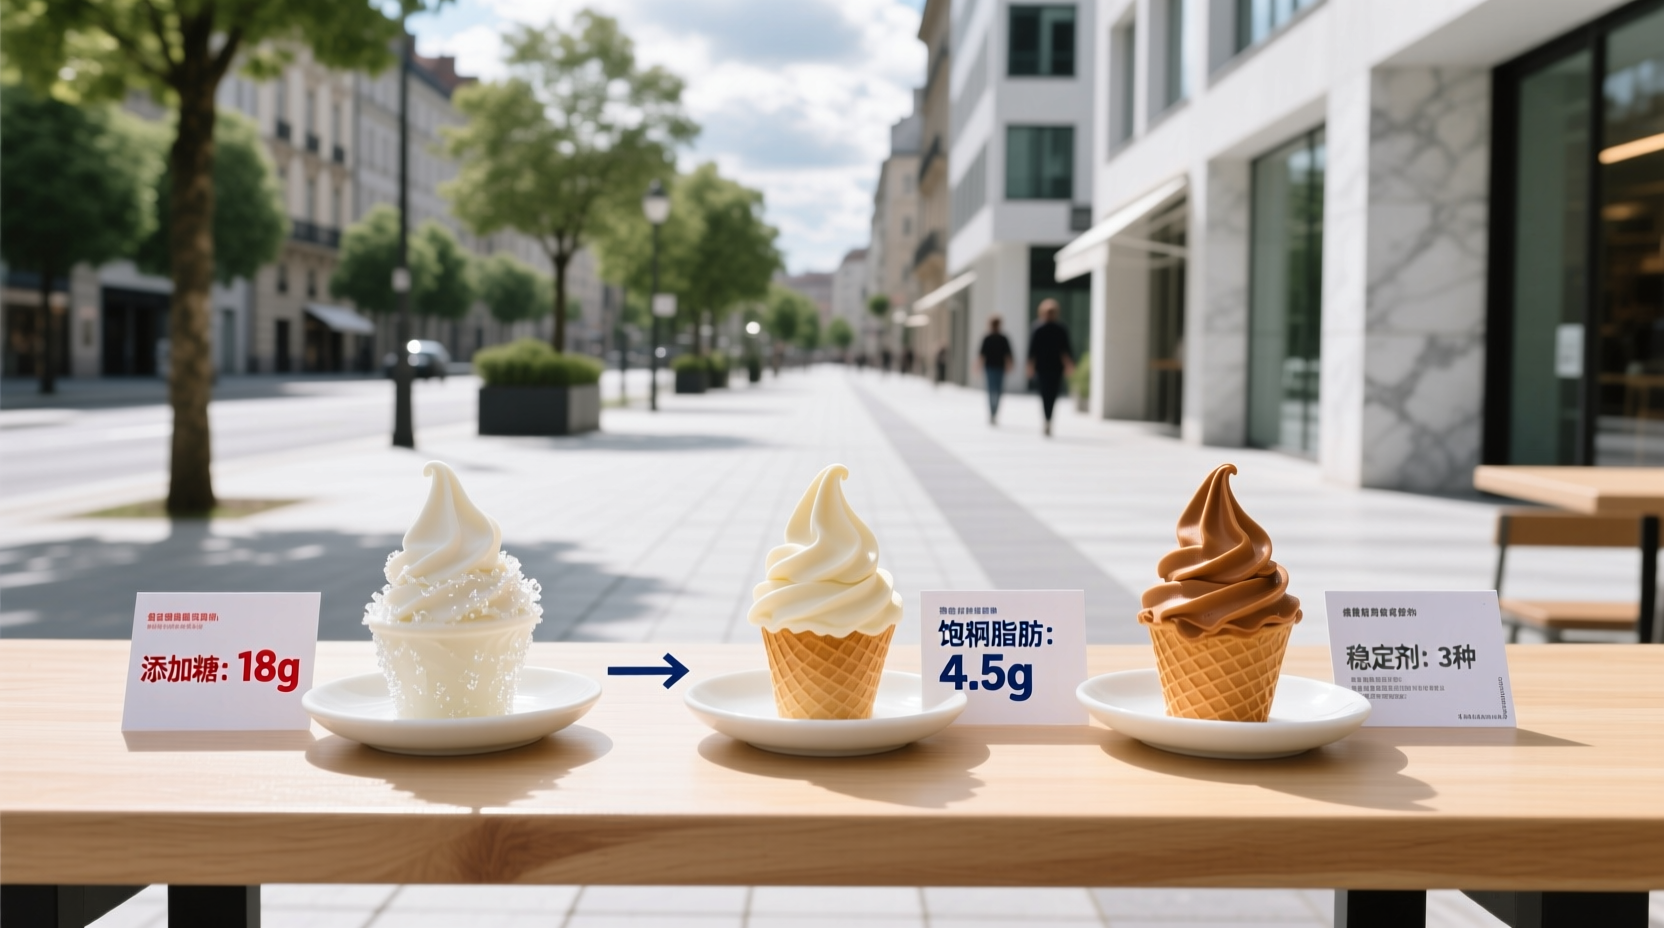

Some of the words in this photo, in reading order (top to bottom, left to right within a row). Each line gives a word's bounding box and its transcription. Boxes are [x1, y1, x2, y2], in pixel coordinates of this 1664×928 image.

[140, 654, 228, 683] 添加糖:
[238, 649, 300, 693] 18g
[939, 653, 1033, 702] 4.5g
[1346, 643, 1429, 671] 稳定剂:
[1437, 643, 1477, 670] 3种
